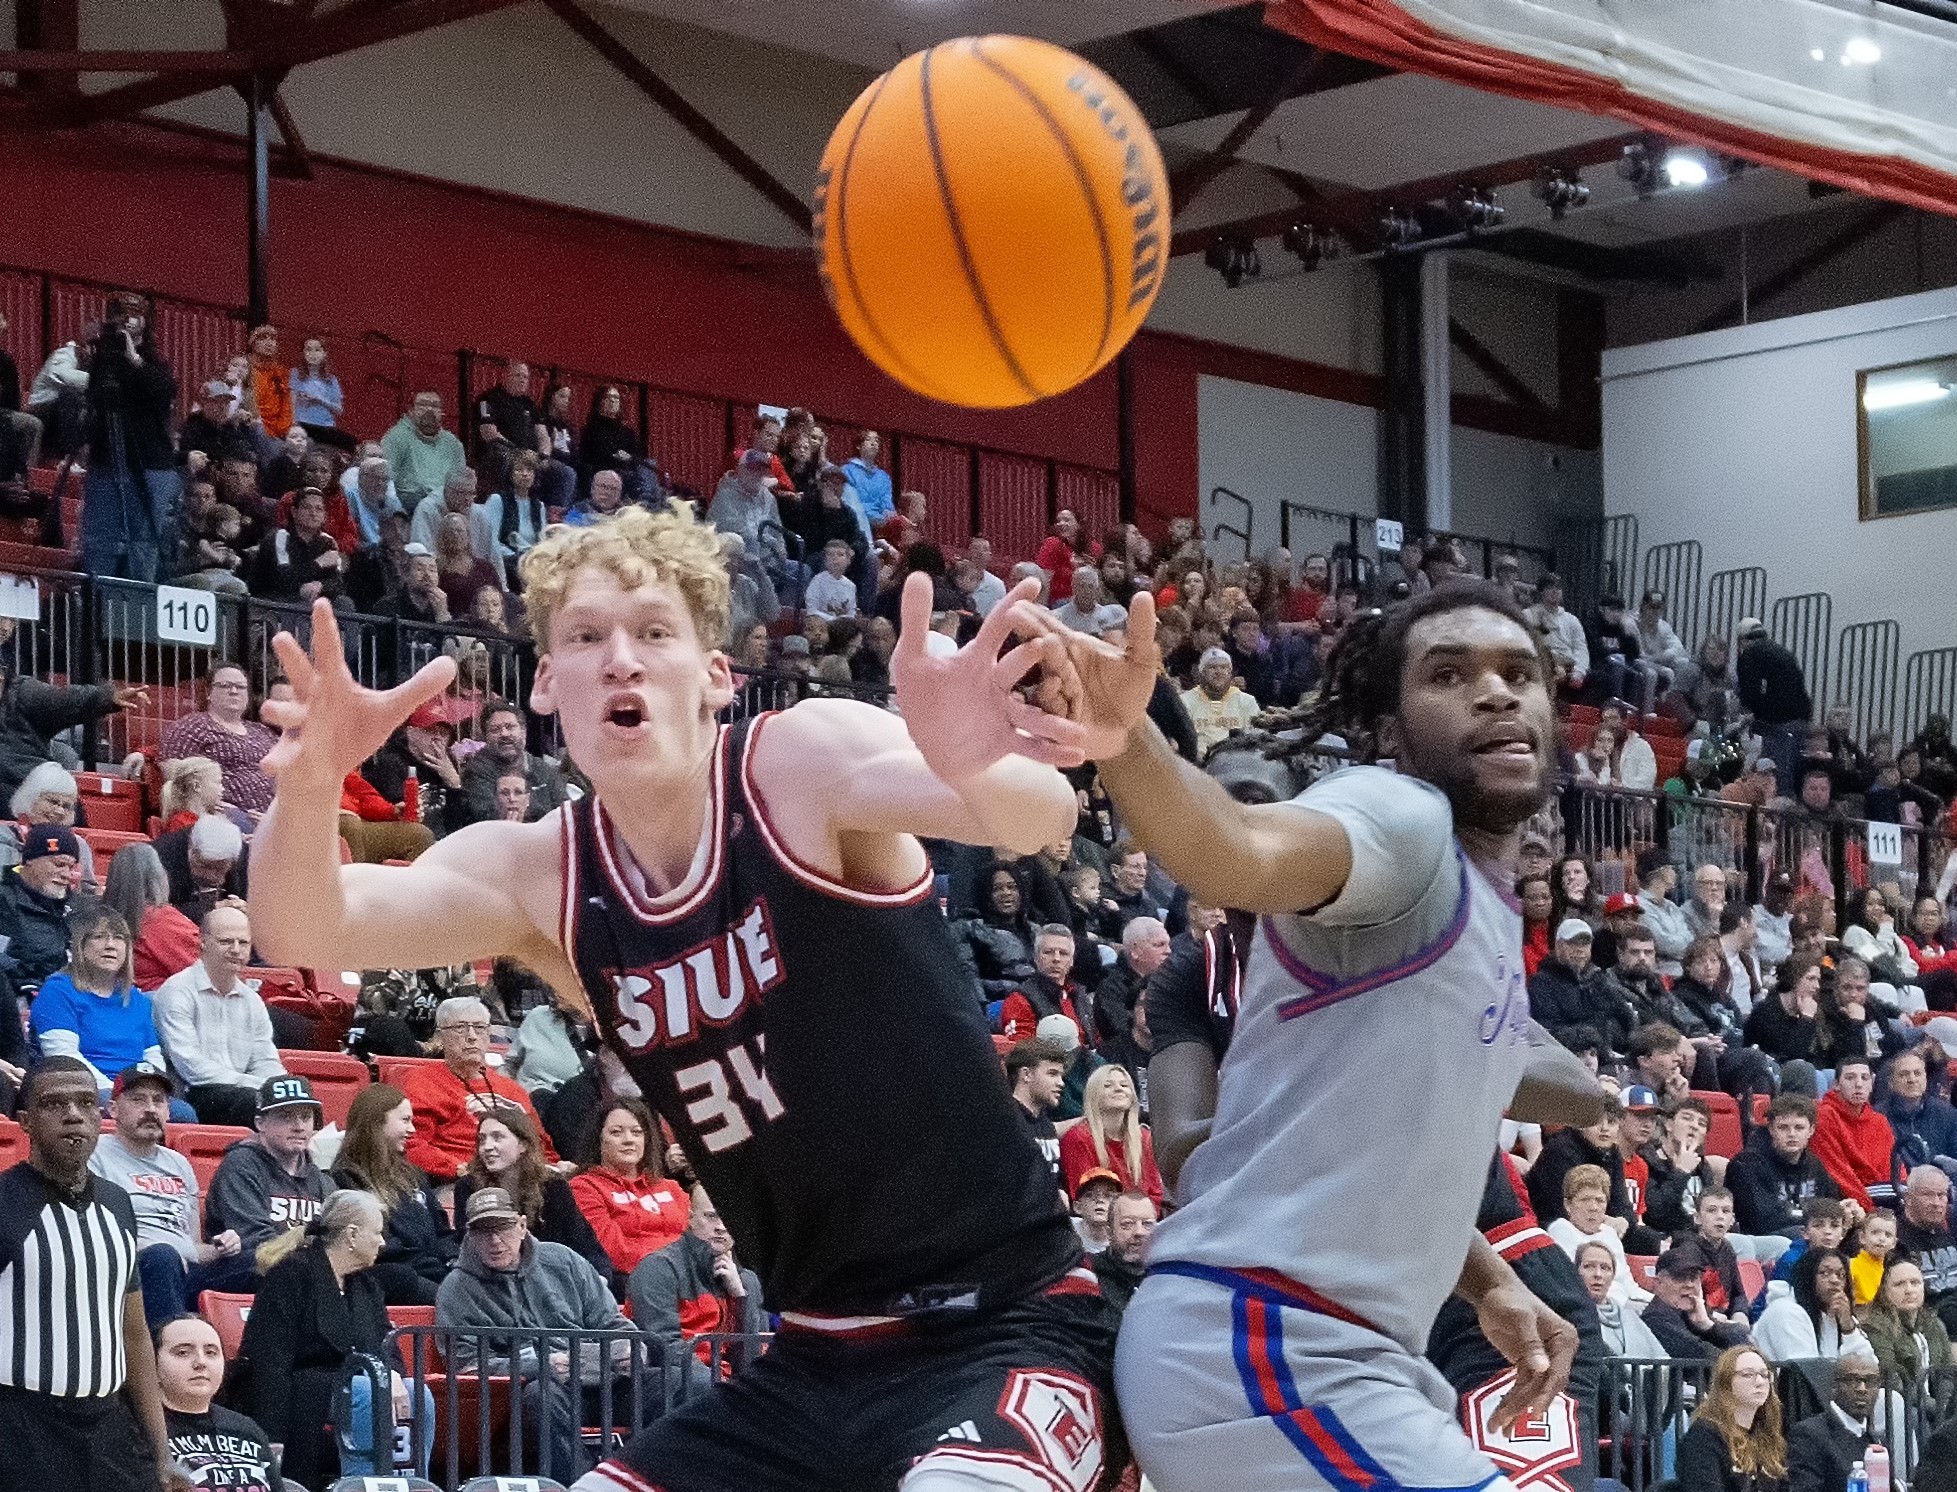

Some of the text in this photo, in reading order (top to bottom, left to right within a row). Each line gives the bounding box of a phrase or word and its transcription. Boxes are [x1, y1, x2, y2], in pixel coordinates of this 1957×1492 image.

[1379, 525, 1401, 544] 213
[163, 599, 210, 633] 110
[1873, 832, 1896, 855] 111
[611, 904, 779, 1048] SIUE
[272, 1079, 309, 1099] STL
[674, 1032, 786, 1153] 34
[215, 1434, 262, 1458] BEAT
[239, 1468, 250, 1485] A
